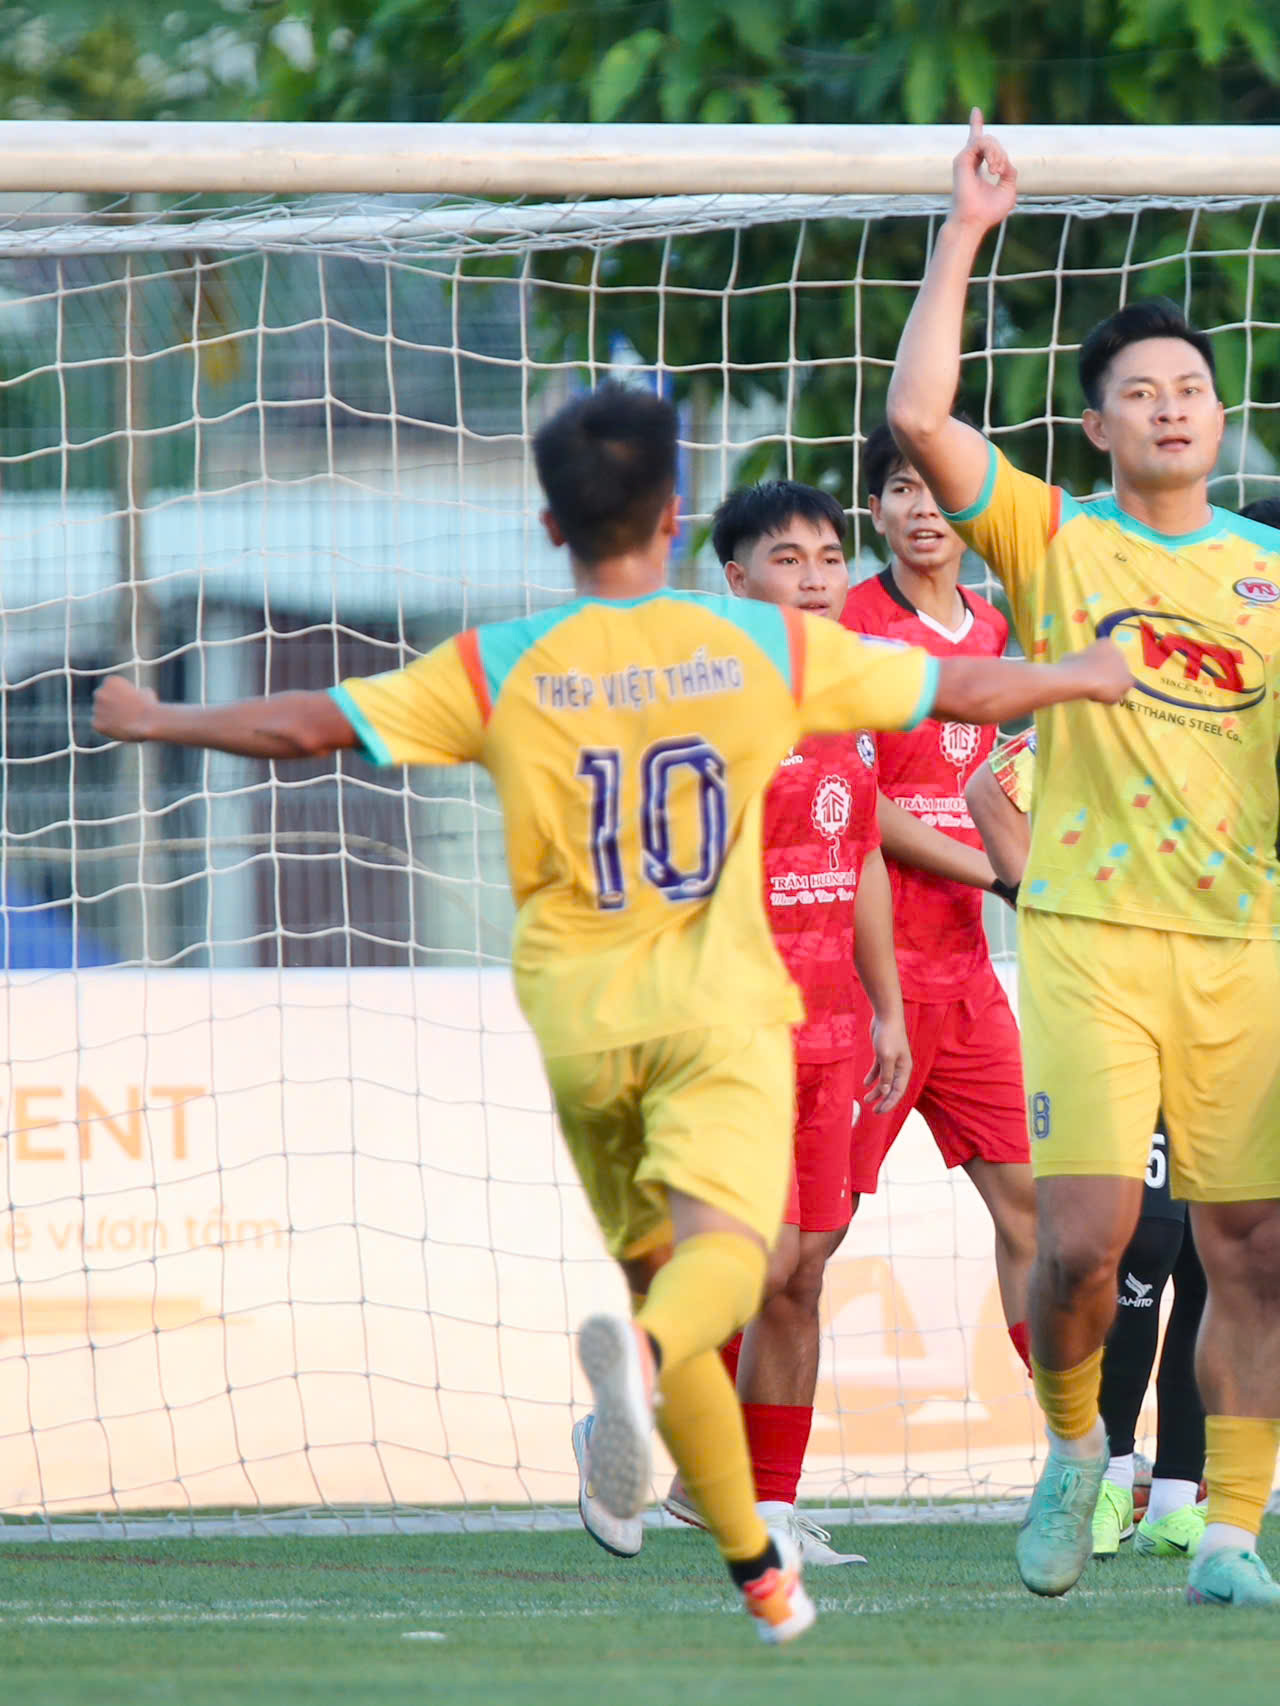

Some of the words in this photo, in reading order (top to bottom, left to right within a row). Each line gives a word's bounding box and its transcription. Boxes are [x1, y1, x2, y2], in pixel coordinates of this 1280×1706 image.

[1189, 717, 1224, 738] STEEL
[578, 732, 728, 910] 10
[0, 1084, 207, 1162] ENT
[1031, 1091, 1051, 1140] 8
